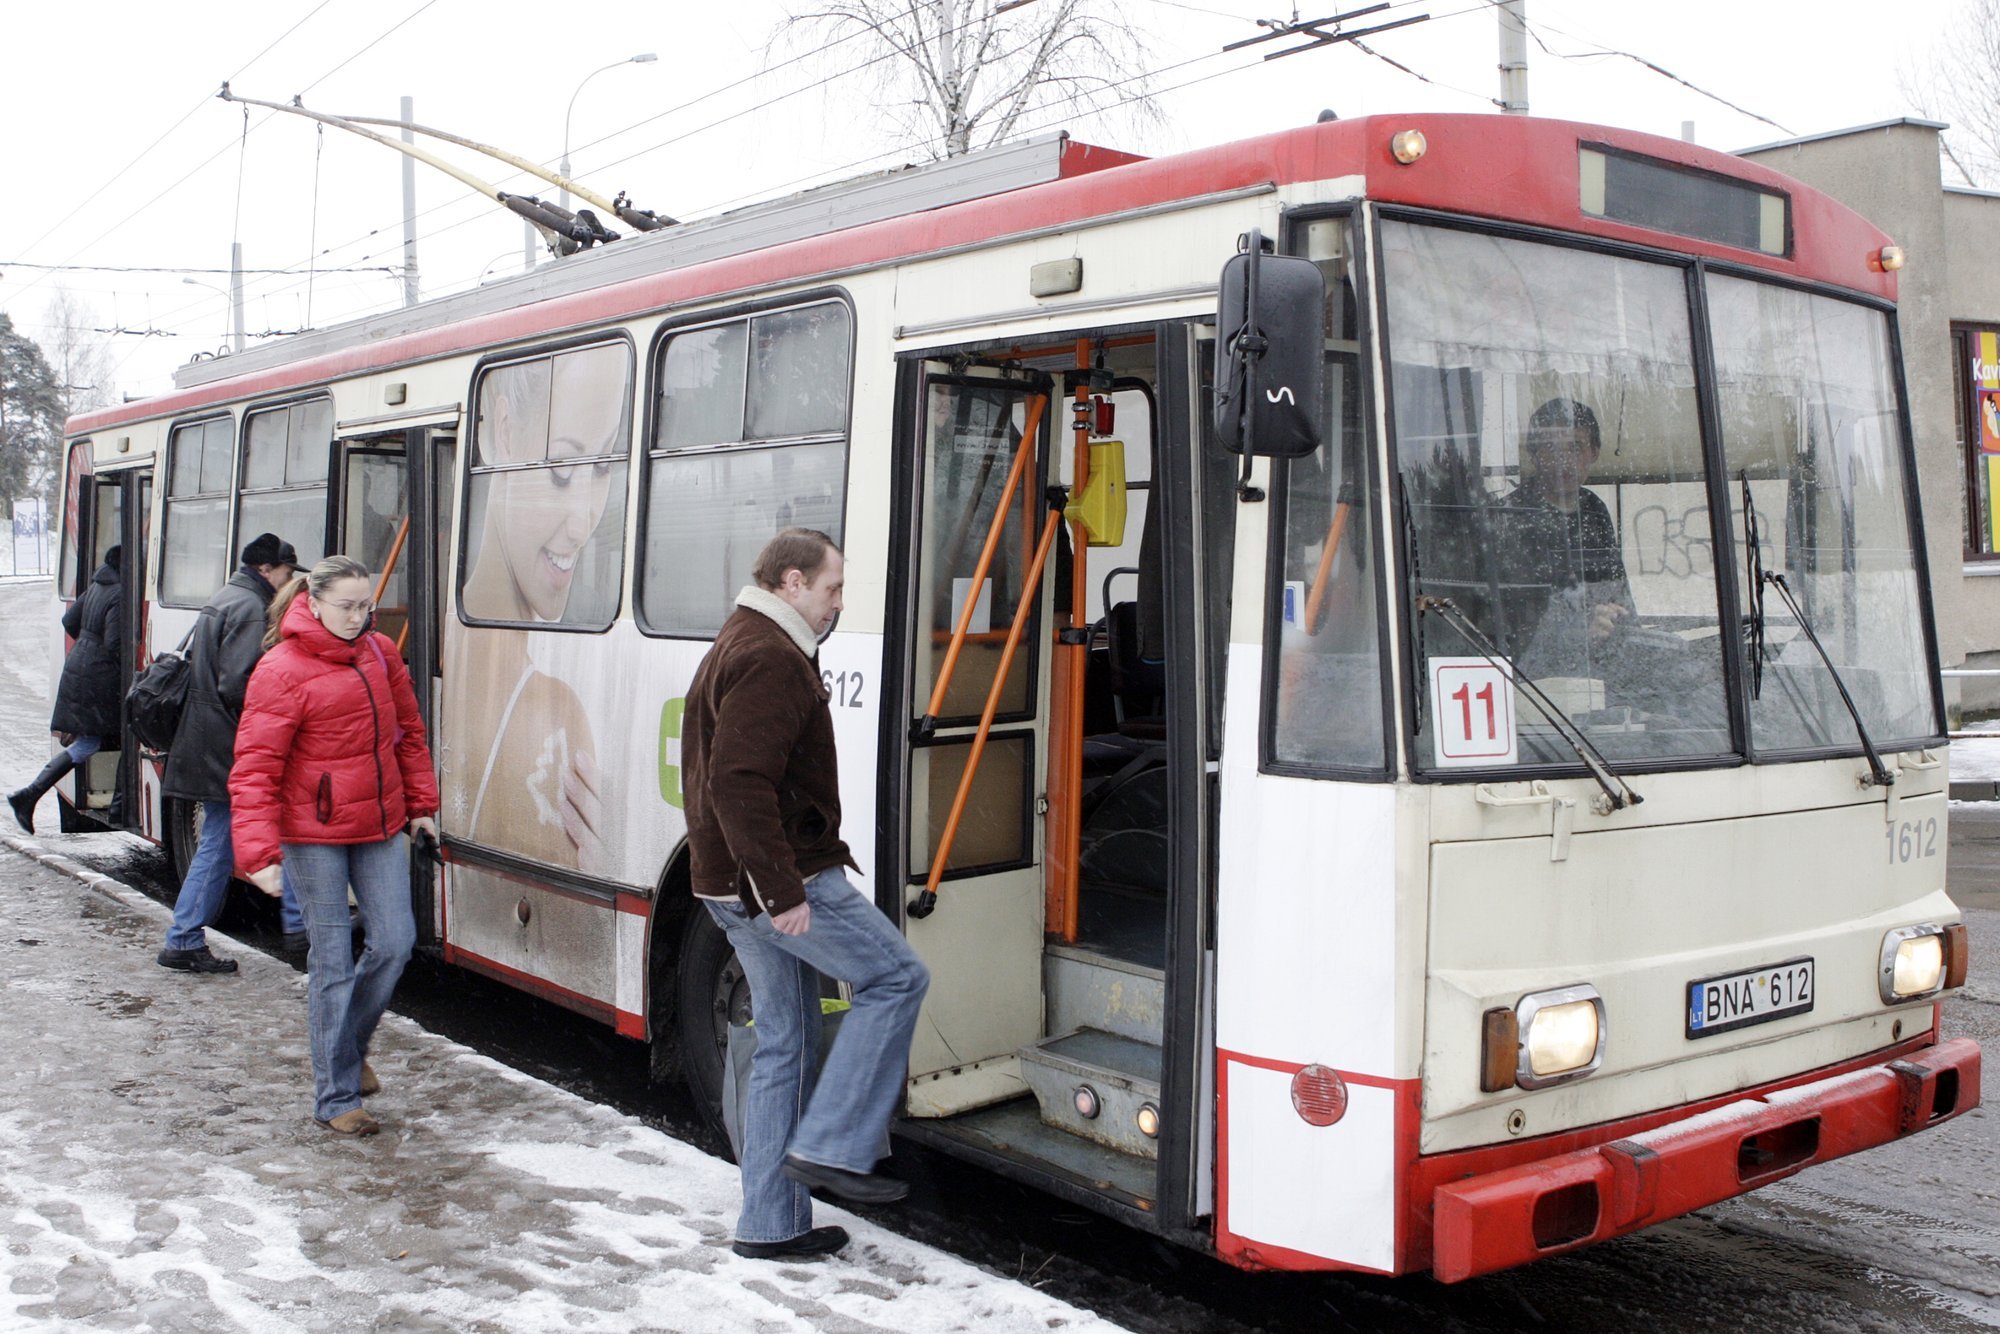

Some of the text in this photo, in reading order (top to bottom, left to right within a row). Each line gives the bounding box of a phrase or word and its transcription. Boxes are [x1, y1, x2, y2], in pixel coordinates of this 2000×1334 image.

[1452, 682, 1496, 740] 11
[1885, 816, 1937, 865] 1612
[1692, 1011, 1703, 1024] LT
[1707, 967, 1809, 1022] BNA 612
